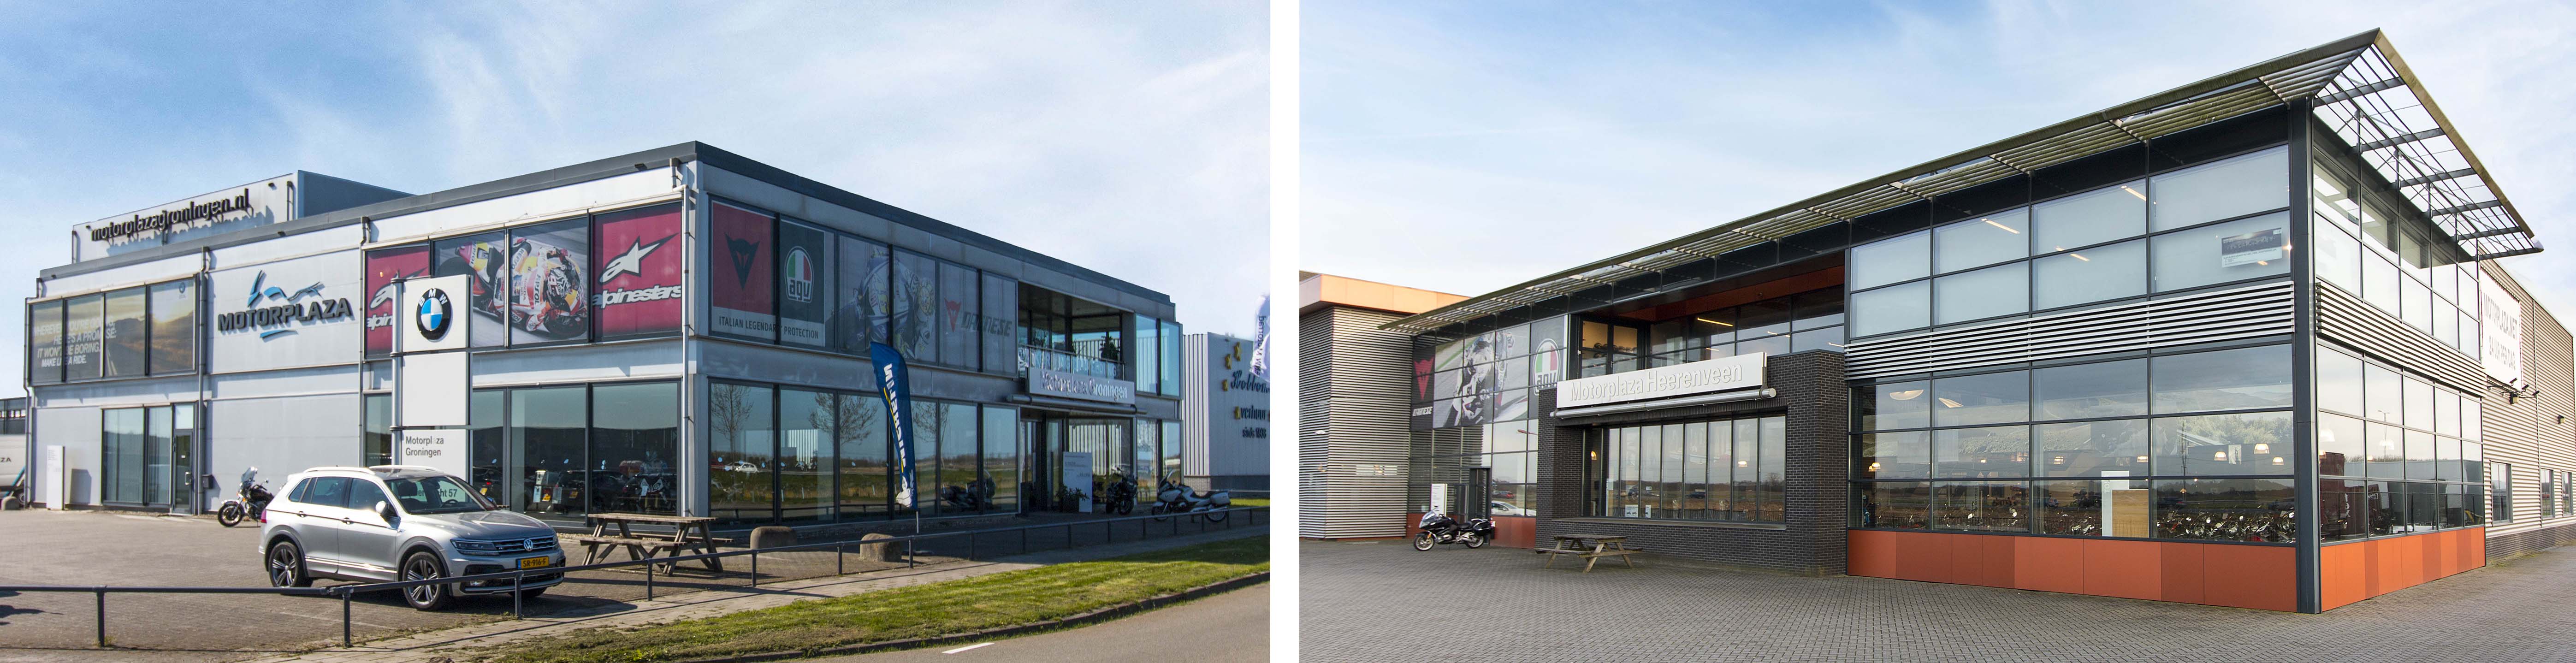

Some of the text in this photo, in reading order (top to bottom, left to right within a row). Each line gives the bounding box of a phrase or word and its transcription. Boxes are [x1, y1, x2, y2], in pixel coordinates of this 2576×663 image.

[91, 188, 249, 241] motorplazagroningen.nl
[512, 249, 524, 270] REPSO
[419, 289, 448, 308] BMW
[592, 285, 681, 309] alpinestars
[789, 279, 811, 301] agv
[218, 298, 352, 332] MOTORPLAZA
[961, 311, 1013, 336] DANESE
[719, 316, 819, 339] ITALIAN LEGENDAR PROTECTION
[75, 342, 101, 355] BORING.
[1040, 371, 1127, 403] Motorplaza Groningen
[1569, 364, 1742, 402] Motorplaza Heerenveen
[1240, 405, 1266, 420] verhuur
[406, 436, 444, 446] Motorplza
[406, 448, 441, 457] Groningen
[449, 489, 457, 497] 57
[523, 558, 546, 567] SR-916-F
